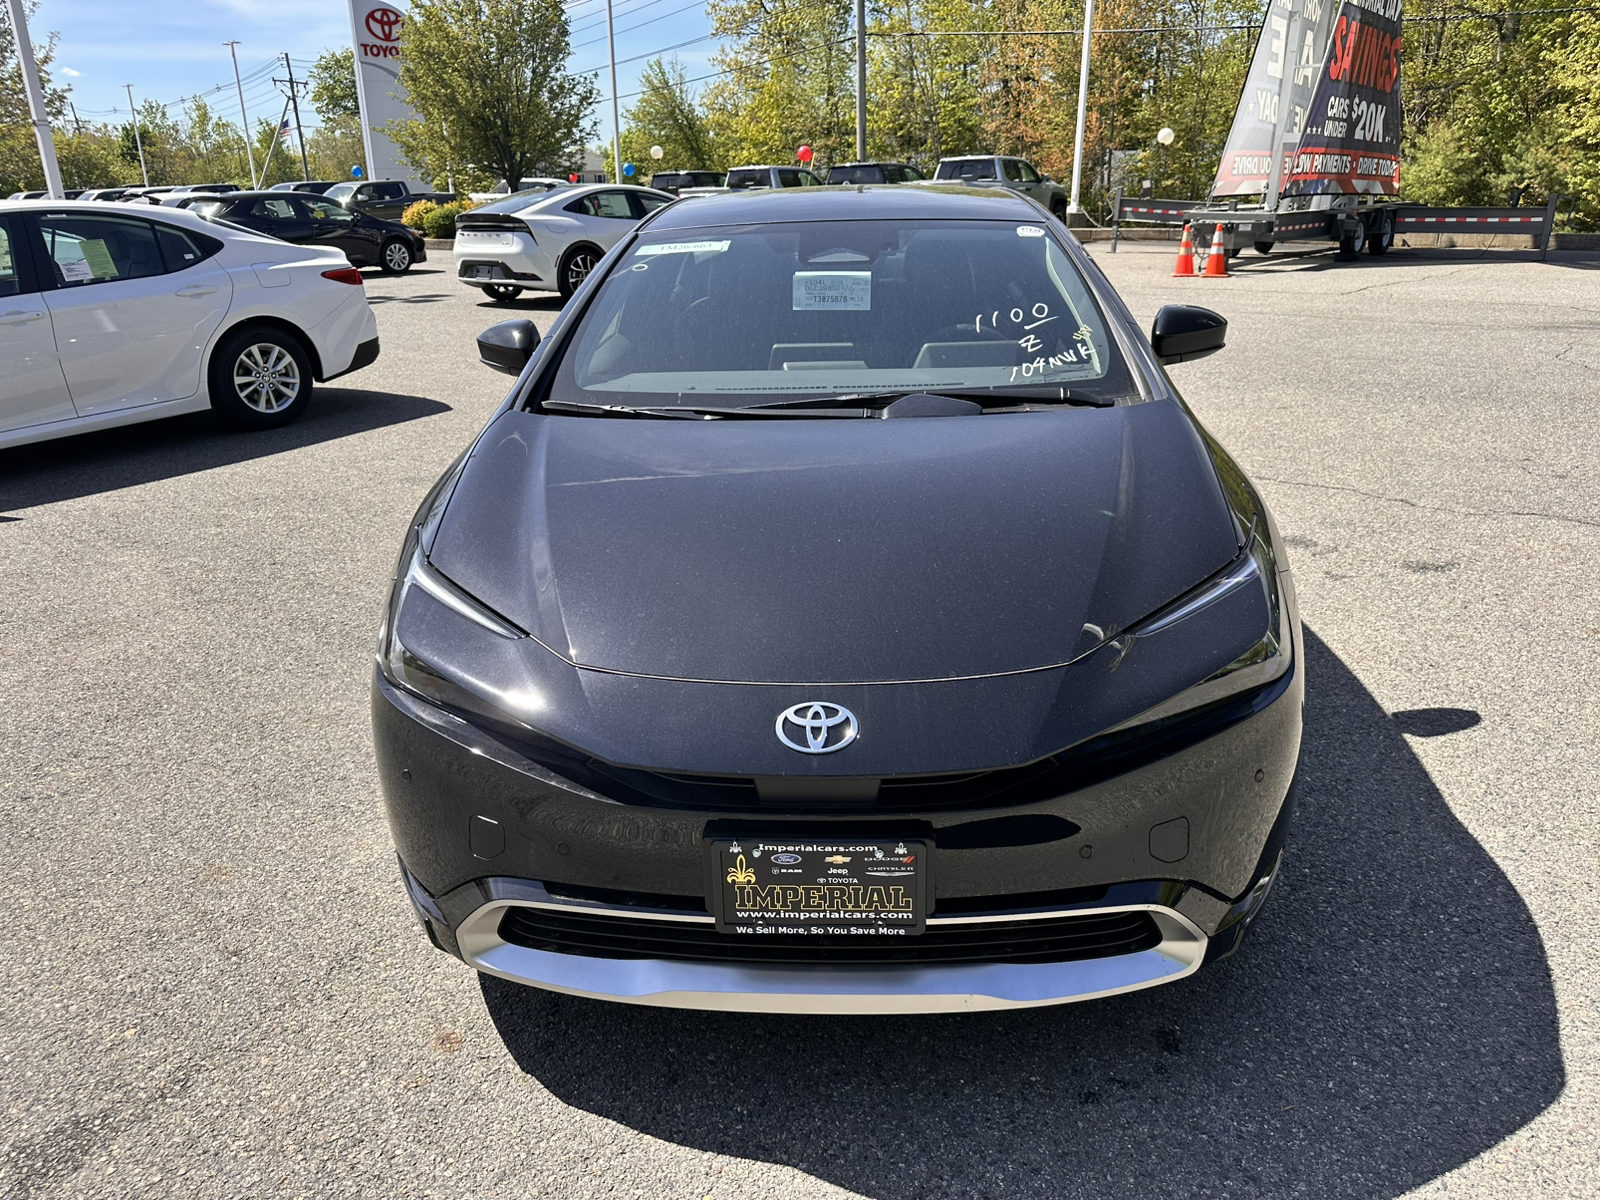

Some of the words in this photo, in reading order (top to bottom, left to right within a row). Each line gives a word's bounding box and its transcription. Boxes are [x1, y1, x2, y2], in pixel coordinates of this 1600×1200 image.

[1384, 0, 1402, 21] DAY
[360, 43, 399, 58] TOYO
[1330, 15, 1402, 93] SAVINGS
[1327, 95, 1350, 119] CARS
[1351, 93, 1386, 143] $20K
[1323, 120, 1347, 138] UNDER
[1292, 154, 1312, 174] LOW
[1312, 154, 1352, 174] PAYMENTS
[1356, 157, 1378, 175] DRIVE
[1378, 159, 1398, 177] TODAY
[758, 843, 878, 853] Imperialcars.com
[777, 855, 795, 863] Ford
[827, 867, 848, 876] Jeep
[734, 884, 913, 911] IMPERIAL
[736, 909, 913, 920] www.imperialcars.com
[736, 926, 754, 934] We
[755, 926, 775, 934] Sell
[778, 927, 808, 935] More,
[810, 927, 824, 935] So
[826, 926, 848, 934] You
[850, 926, 876, 935] Save
[879, 927, 906, 935] More
